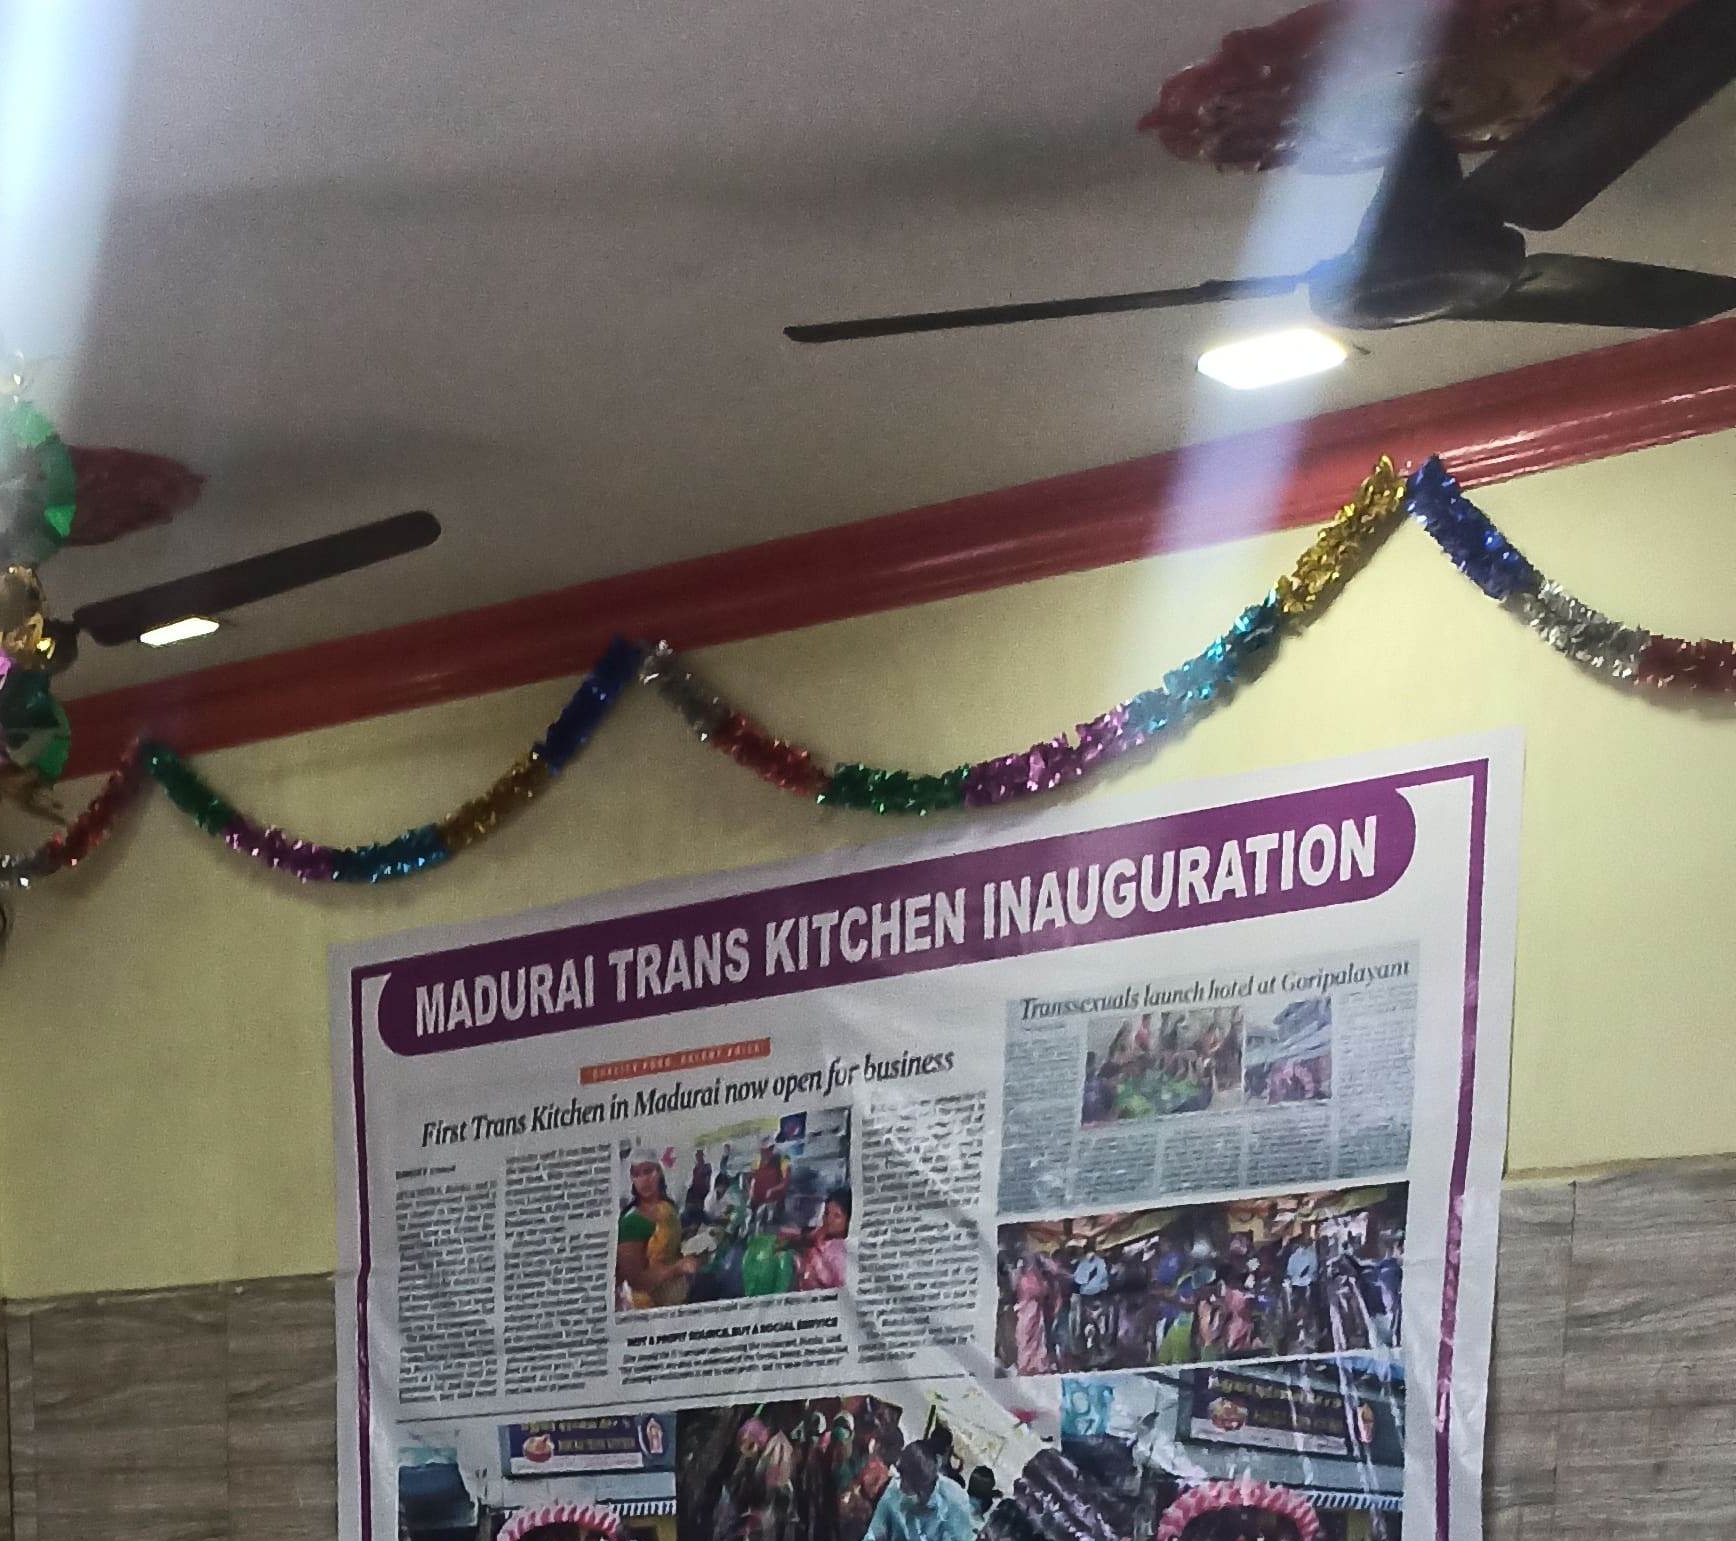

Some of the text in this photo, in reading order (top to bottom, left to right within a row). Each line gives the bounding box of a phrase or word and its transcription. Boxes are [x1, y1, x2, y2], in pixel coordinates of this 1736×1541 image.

[416, 815, 1378, 1037] MADURAI TRANS KITCHEN INAUGURATION
[1021, 959, 1410, 1020] Transsexuals launch hotel at Goripalayam
[421, 1050, 955, 1147] First Trans Kitchen in Madurai now open for business
